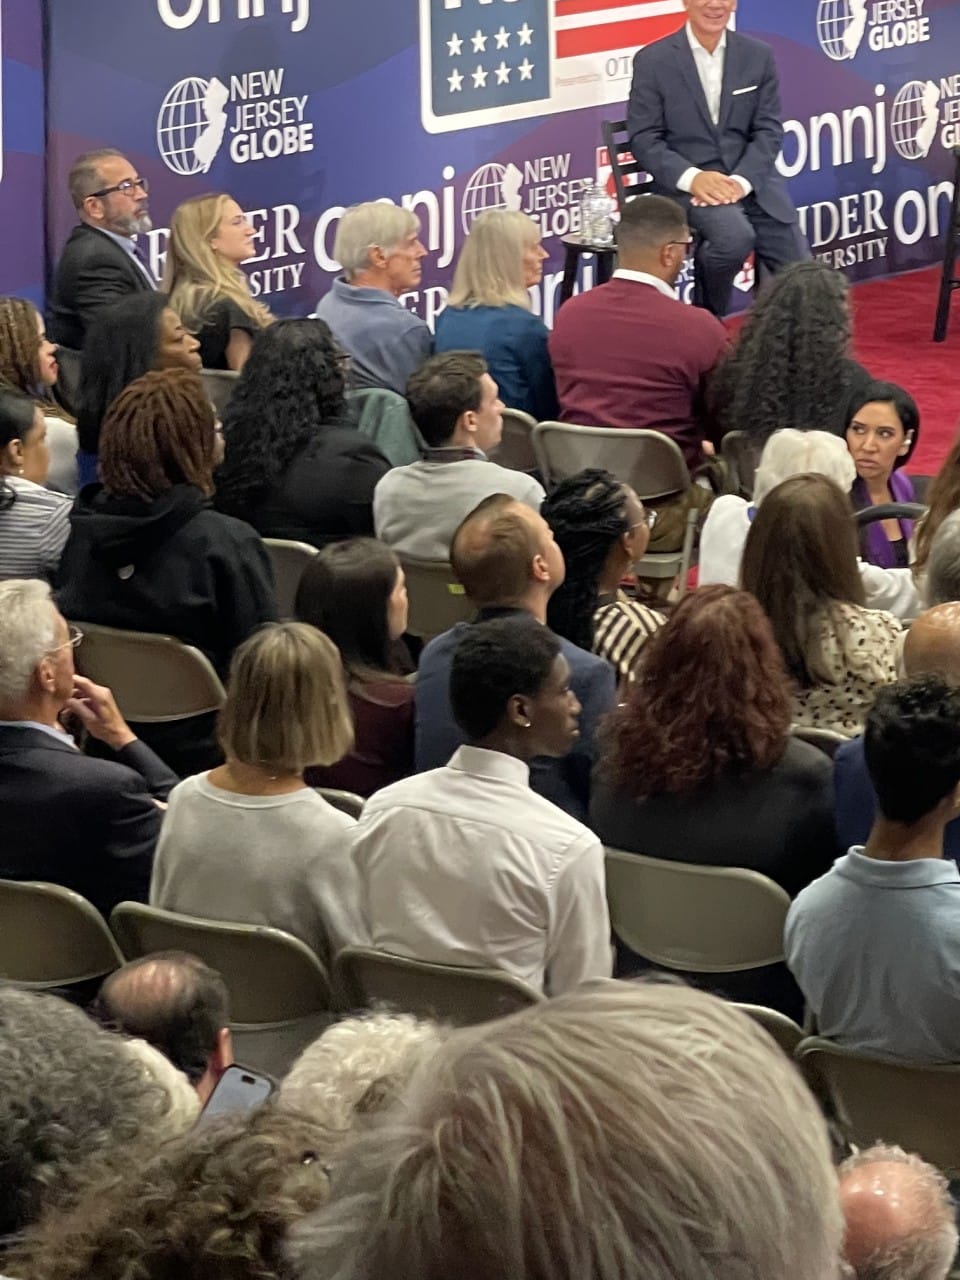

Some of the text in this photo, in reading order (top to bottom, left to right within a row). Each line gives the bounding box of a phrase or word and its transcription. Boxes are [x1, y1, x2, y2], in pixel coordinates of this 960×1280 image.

[868, 16, 931, 53] GLOBE
[229, 68, 284, 103] NEW
[229, 95, 309, 134] JERSEY
[775, 83, 886, 178] onnj
[229, 123, 315, 164] GLOBE
[524, 153, 571, 185] NEW
[796, 189, 889, 248] IDER
